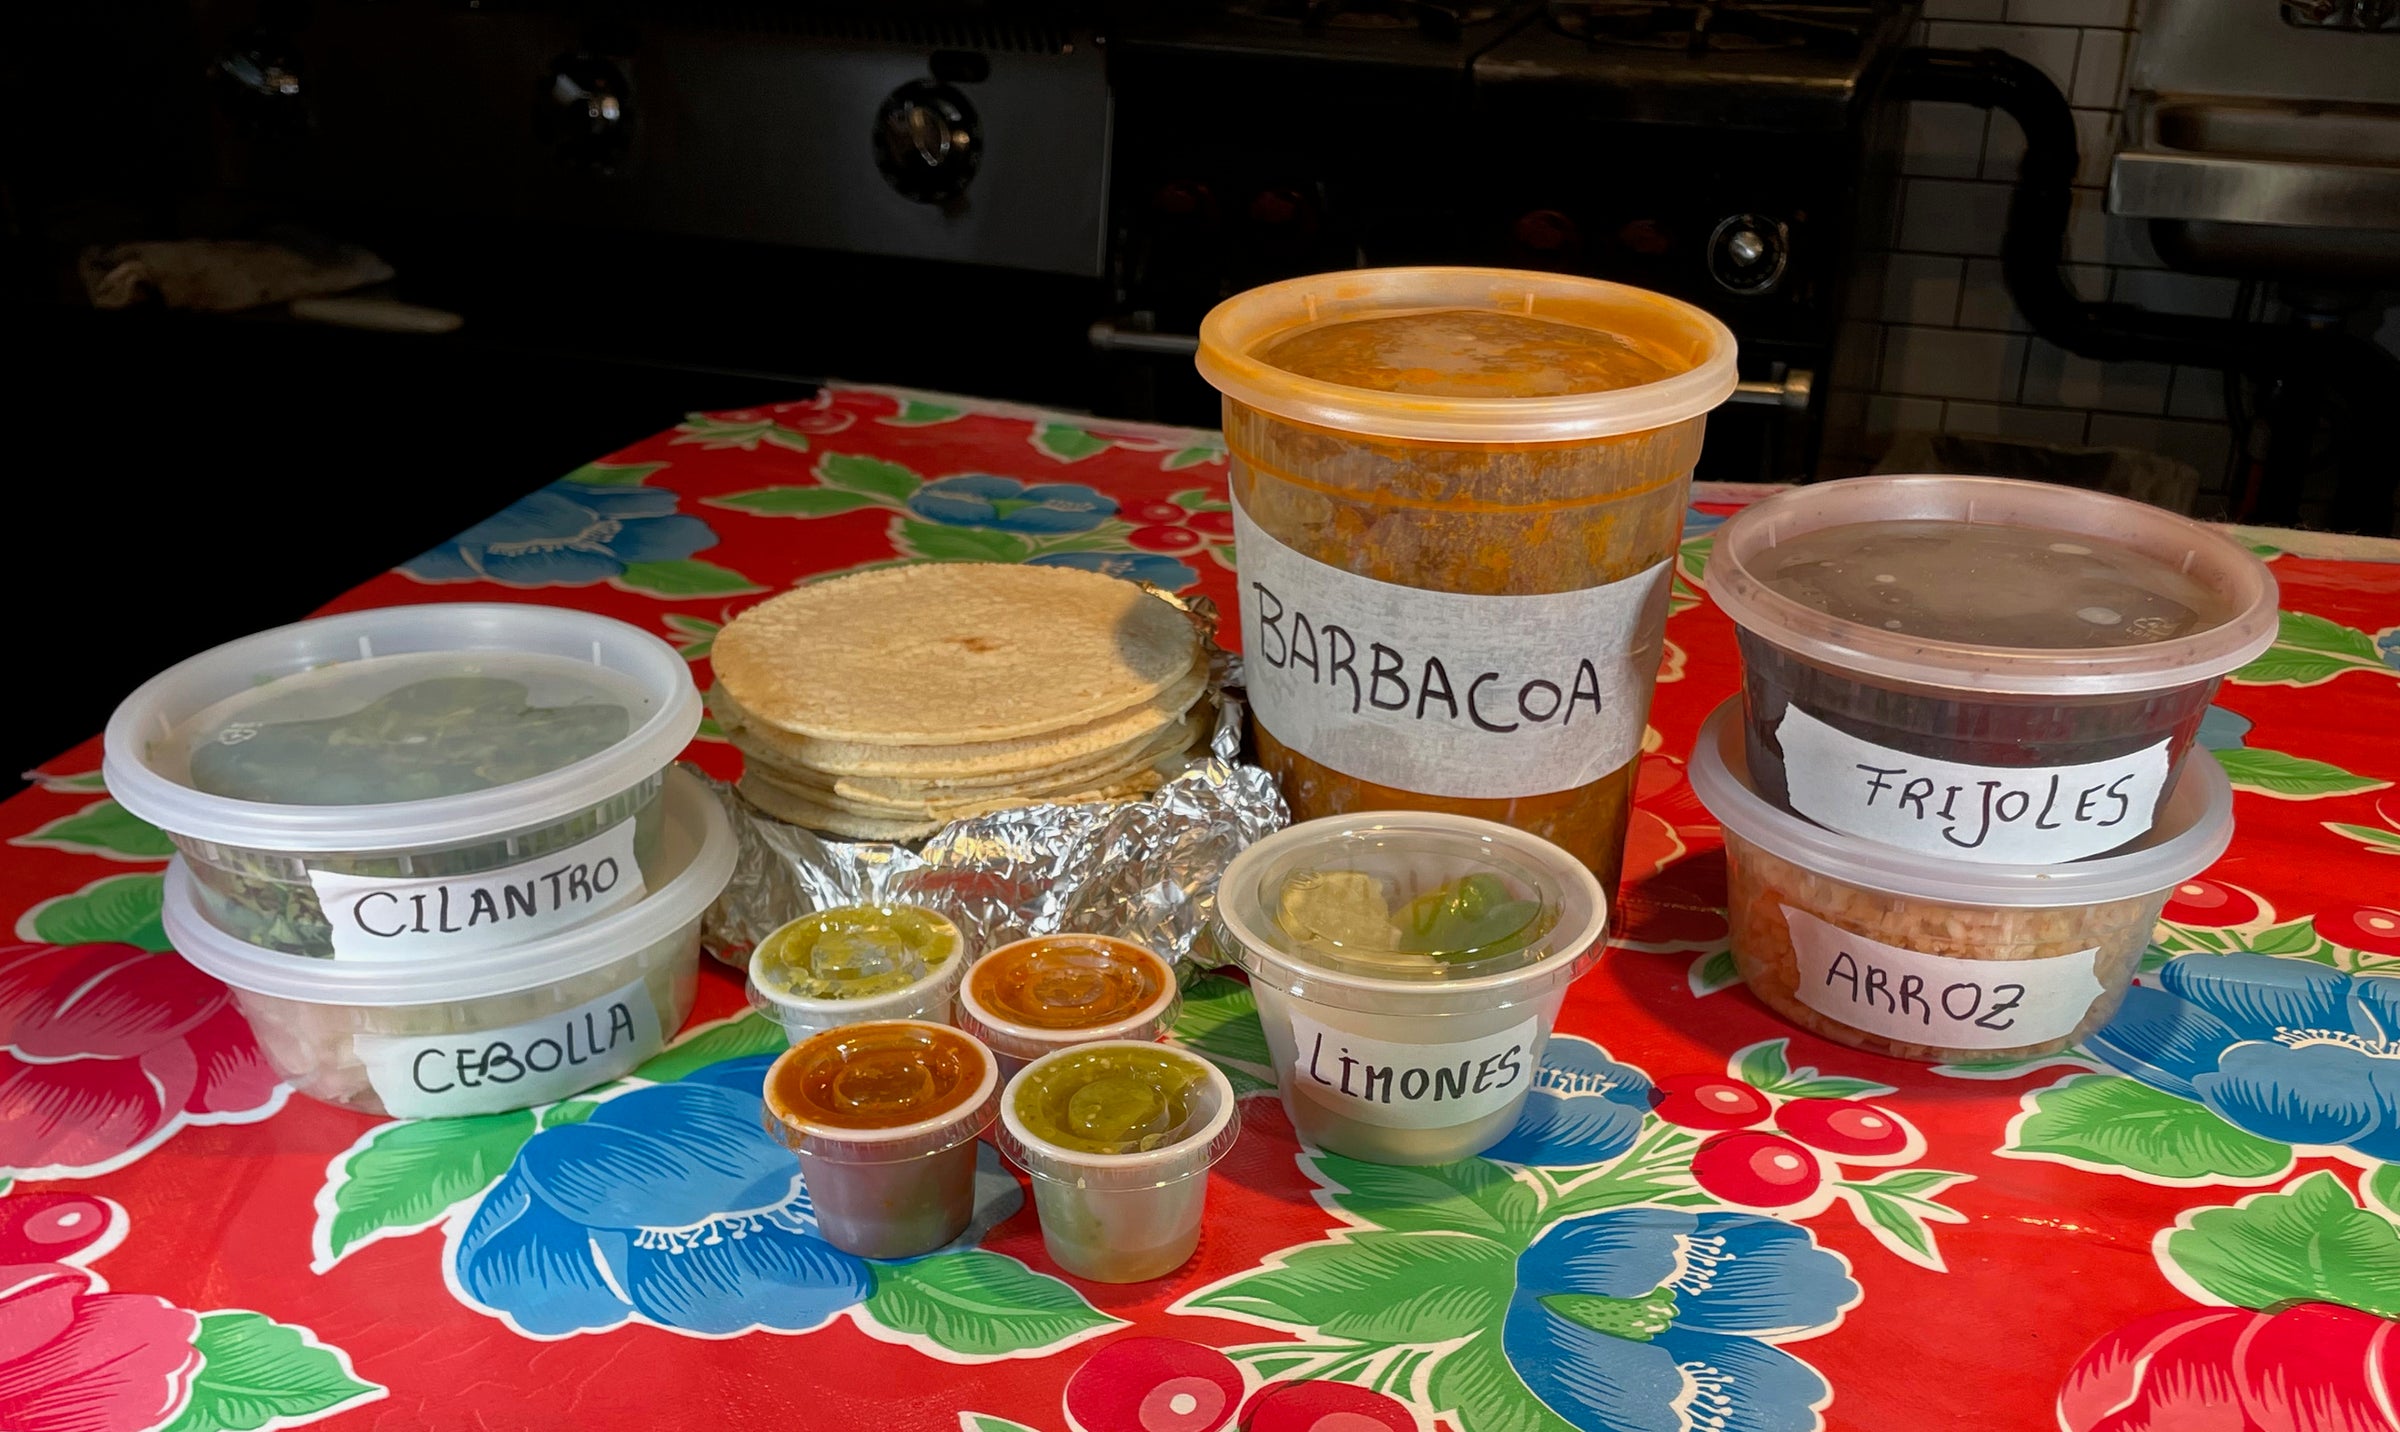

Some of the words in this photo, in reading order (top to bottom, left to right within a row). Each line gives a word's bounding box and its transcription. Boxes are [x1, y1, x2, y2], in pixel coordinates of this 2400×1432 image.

[1253, 581, 1601, 733] BARBACOA
[1856, 762, 2135, 848] FRIJOLES
[353, 857, 619, 937] CILANTRO
[1825, 951, 2025, 1030] ARROZ
[413, 1002, 636, 1093] CEBOLLA
